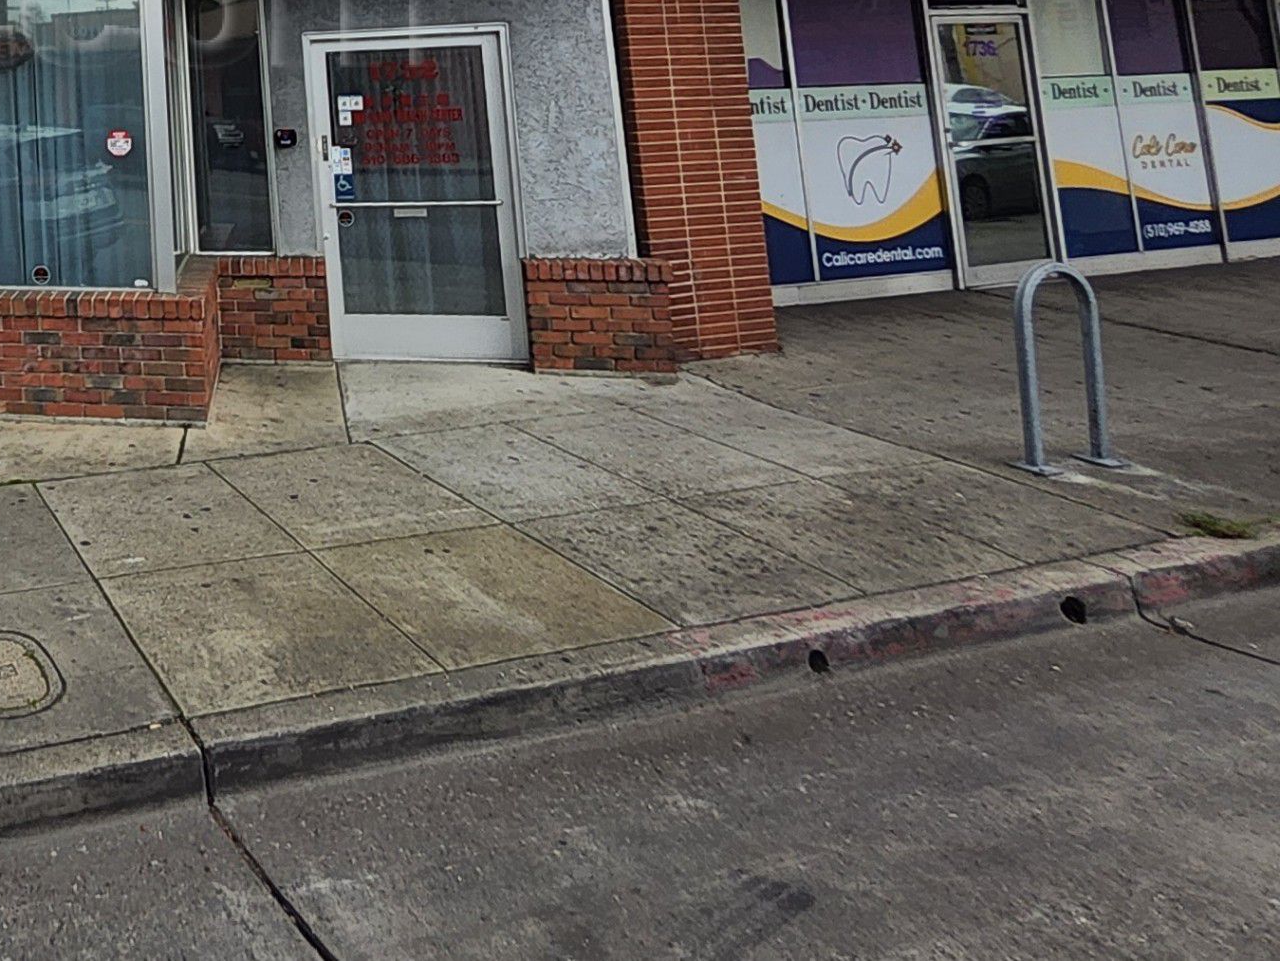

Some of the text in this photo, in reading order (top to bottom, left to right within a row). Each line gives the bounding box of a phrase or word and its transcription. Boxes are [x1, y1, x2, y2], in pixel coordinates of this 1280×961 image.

[1050, 81, 1100, 100] Dentist
[1132, 80, 1179, 99] Dentist
[1217, 76, 1262, 94] Dentist
[750, 91, 923, 115] ntist Dentist Dentist
[1141, 159, 1192, 170] DENTAL
[822, 246, 944, 267] Calicaredental.com
